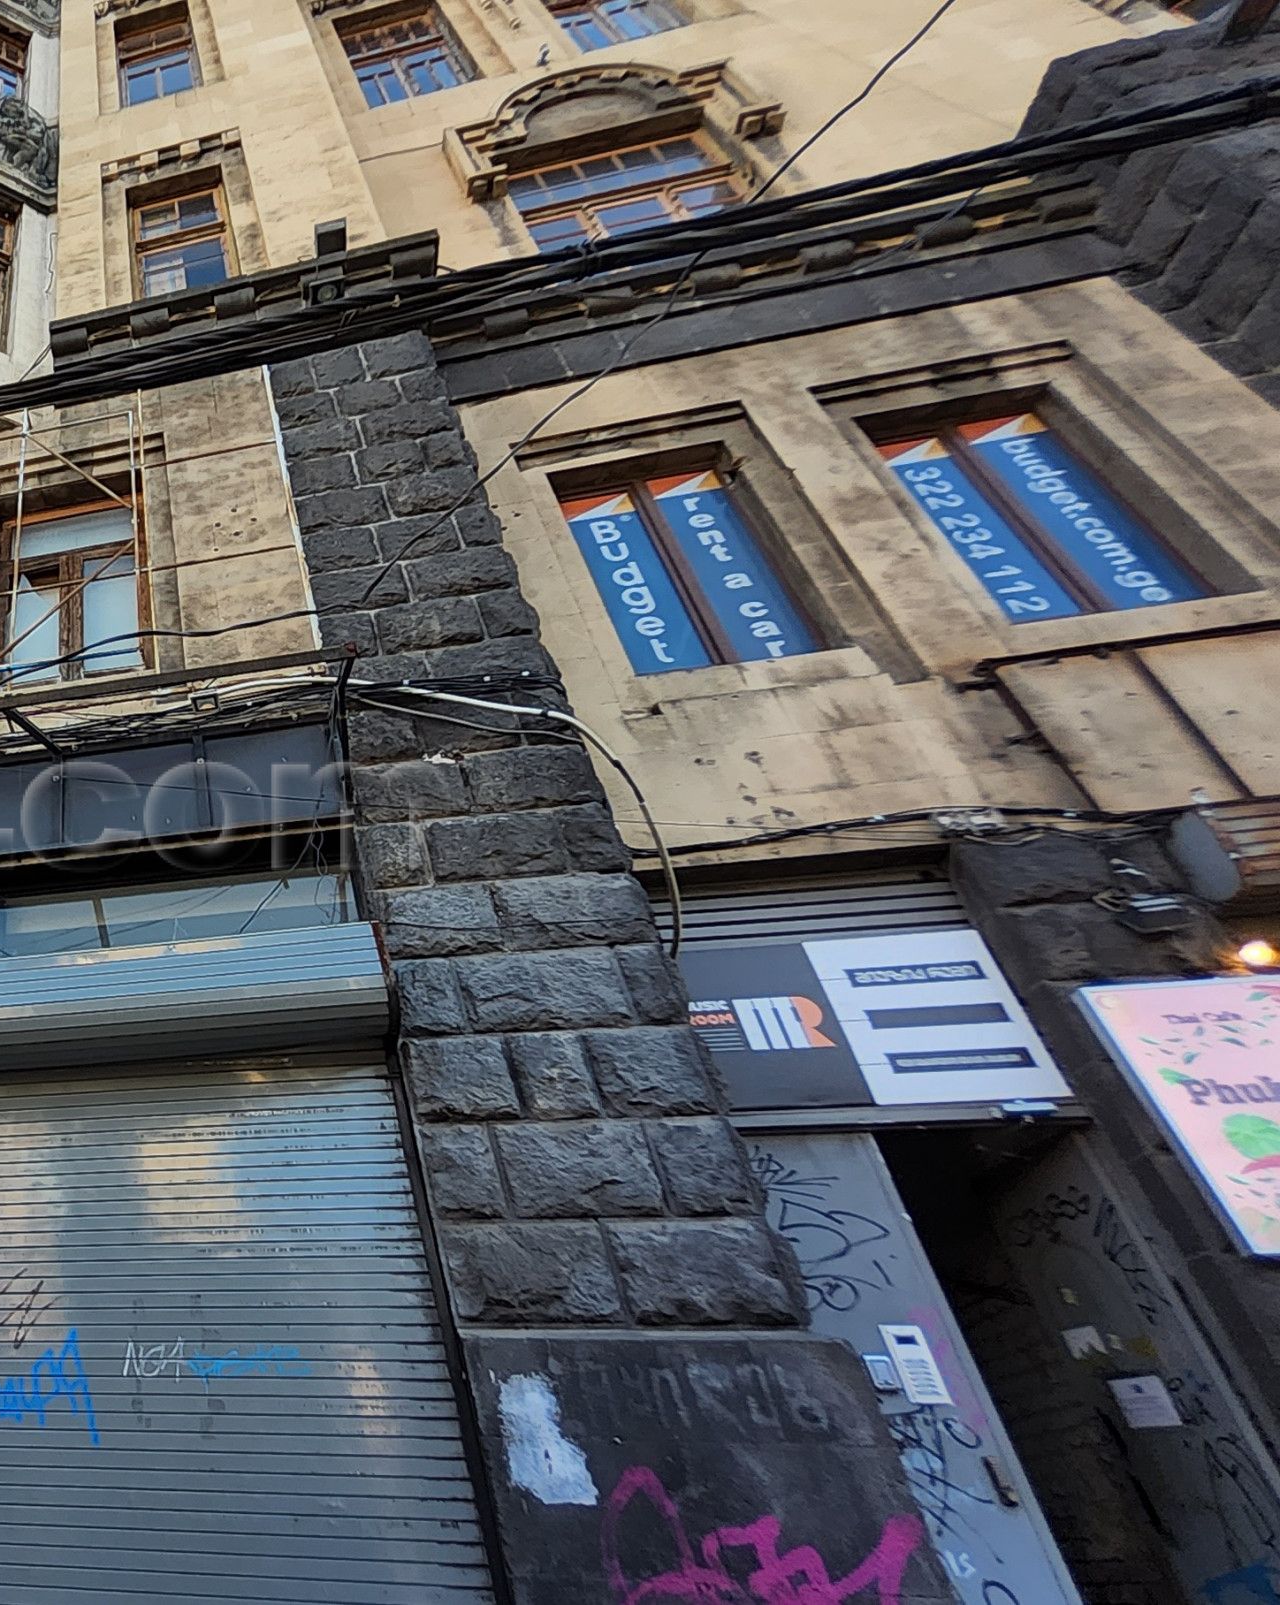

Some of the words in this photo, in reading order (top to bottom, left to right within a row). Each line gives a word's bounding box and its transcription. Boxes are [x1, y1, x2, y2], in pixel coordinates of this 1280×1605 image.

[589, 520, 675, 663] Budget
[683, 497, 733, 561] rent
[723, 573, 753, 589] a
[739, 601, 786, 657] car
[904, 466, 965, 510] 322
[940, 514, 1006, 559] 234
[984, 565, 1051, 613] 112
